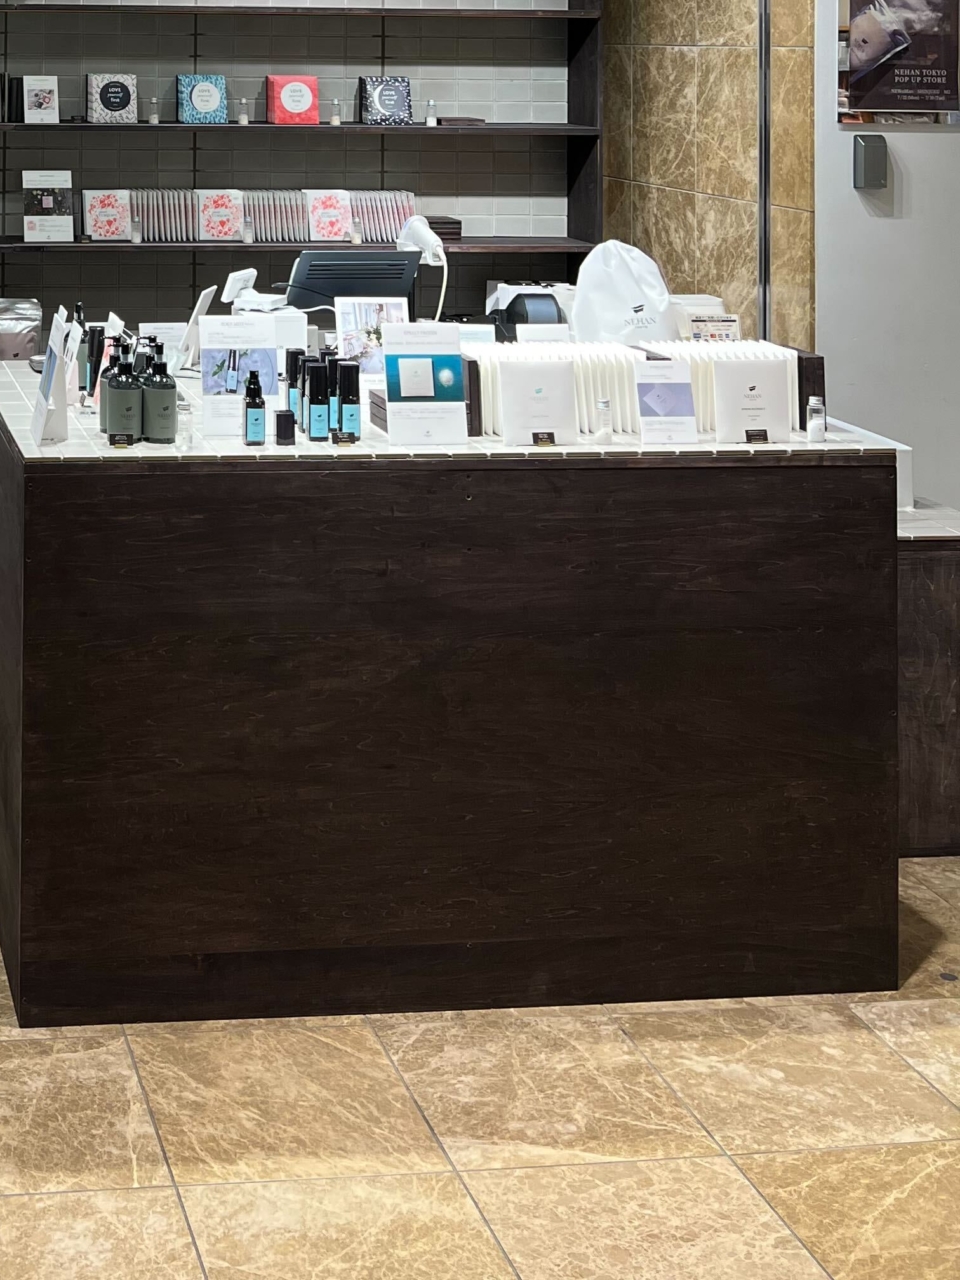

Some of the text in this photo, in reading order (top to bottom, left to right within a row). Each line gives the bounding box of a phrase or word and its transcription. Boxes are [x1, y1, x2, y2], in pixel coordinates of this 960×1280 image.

[894, 68, 921, 76] NEHAN
[922, 76, 947, 84] STORE
[624, 317, 656, 327] NEHAN
